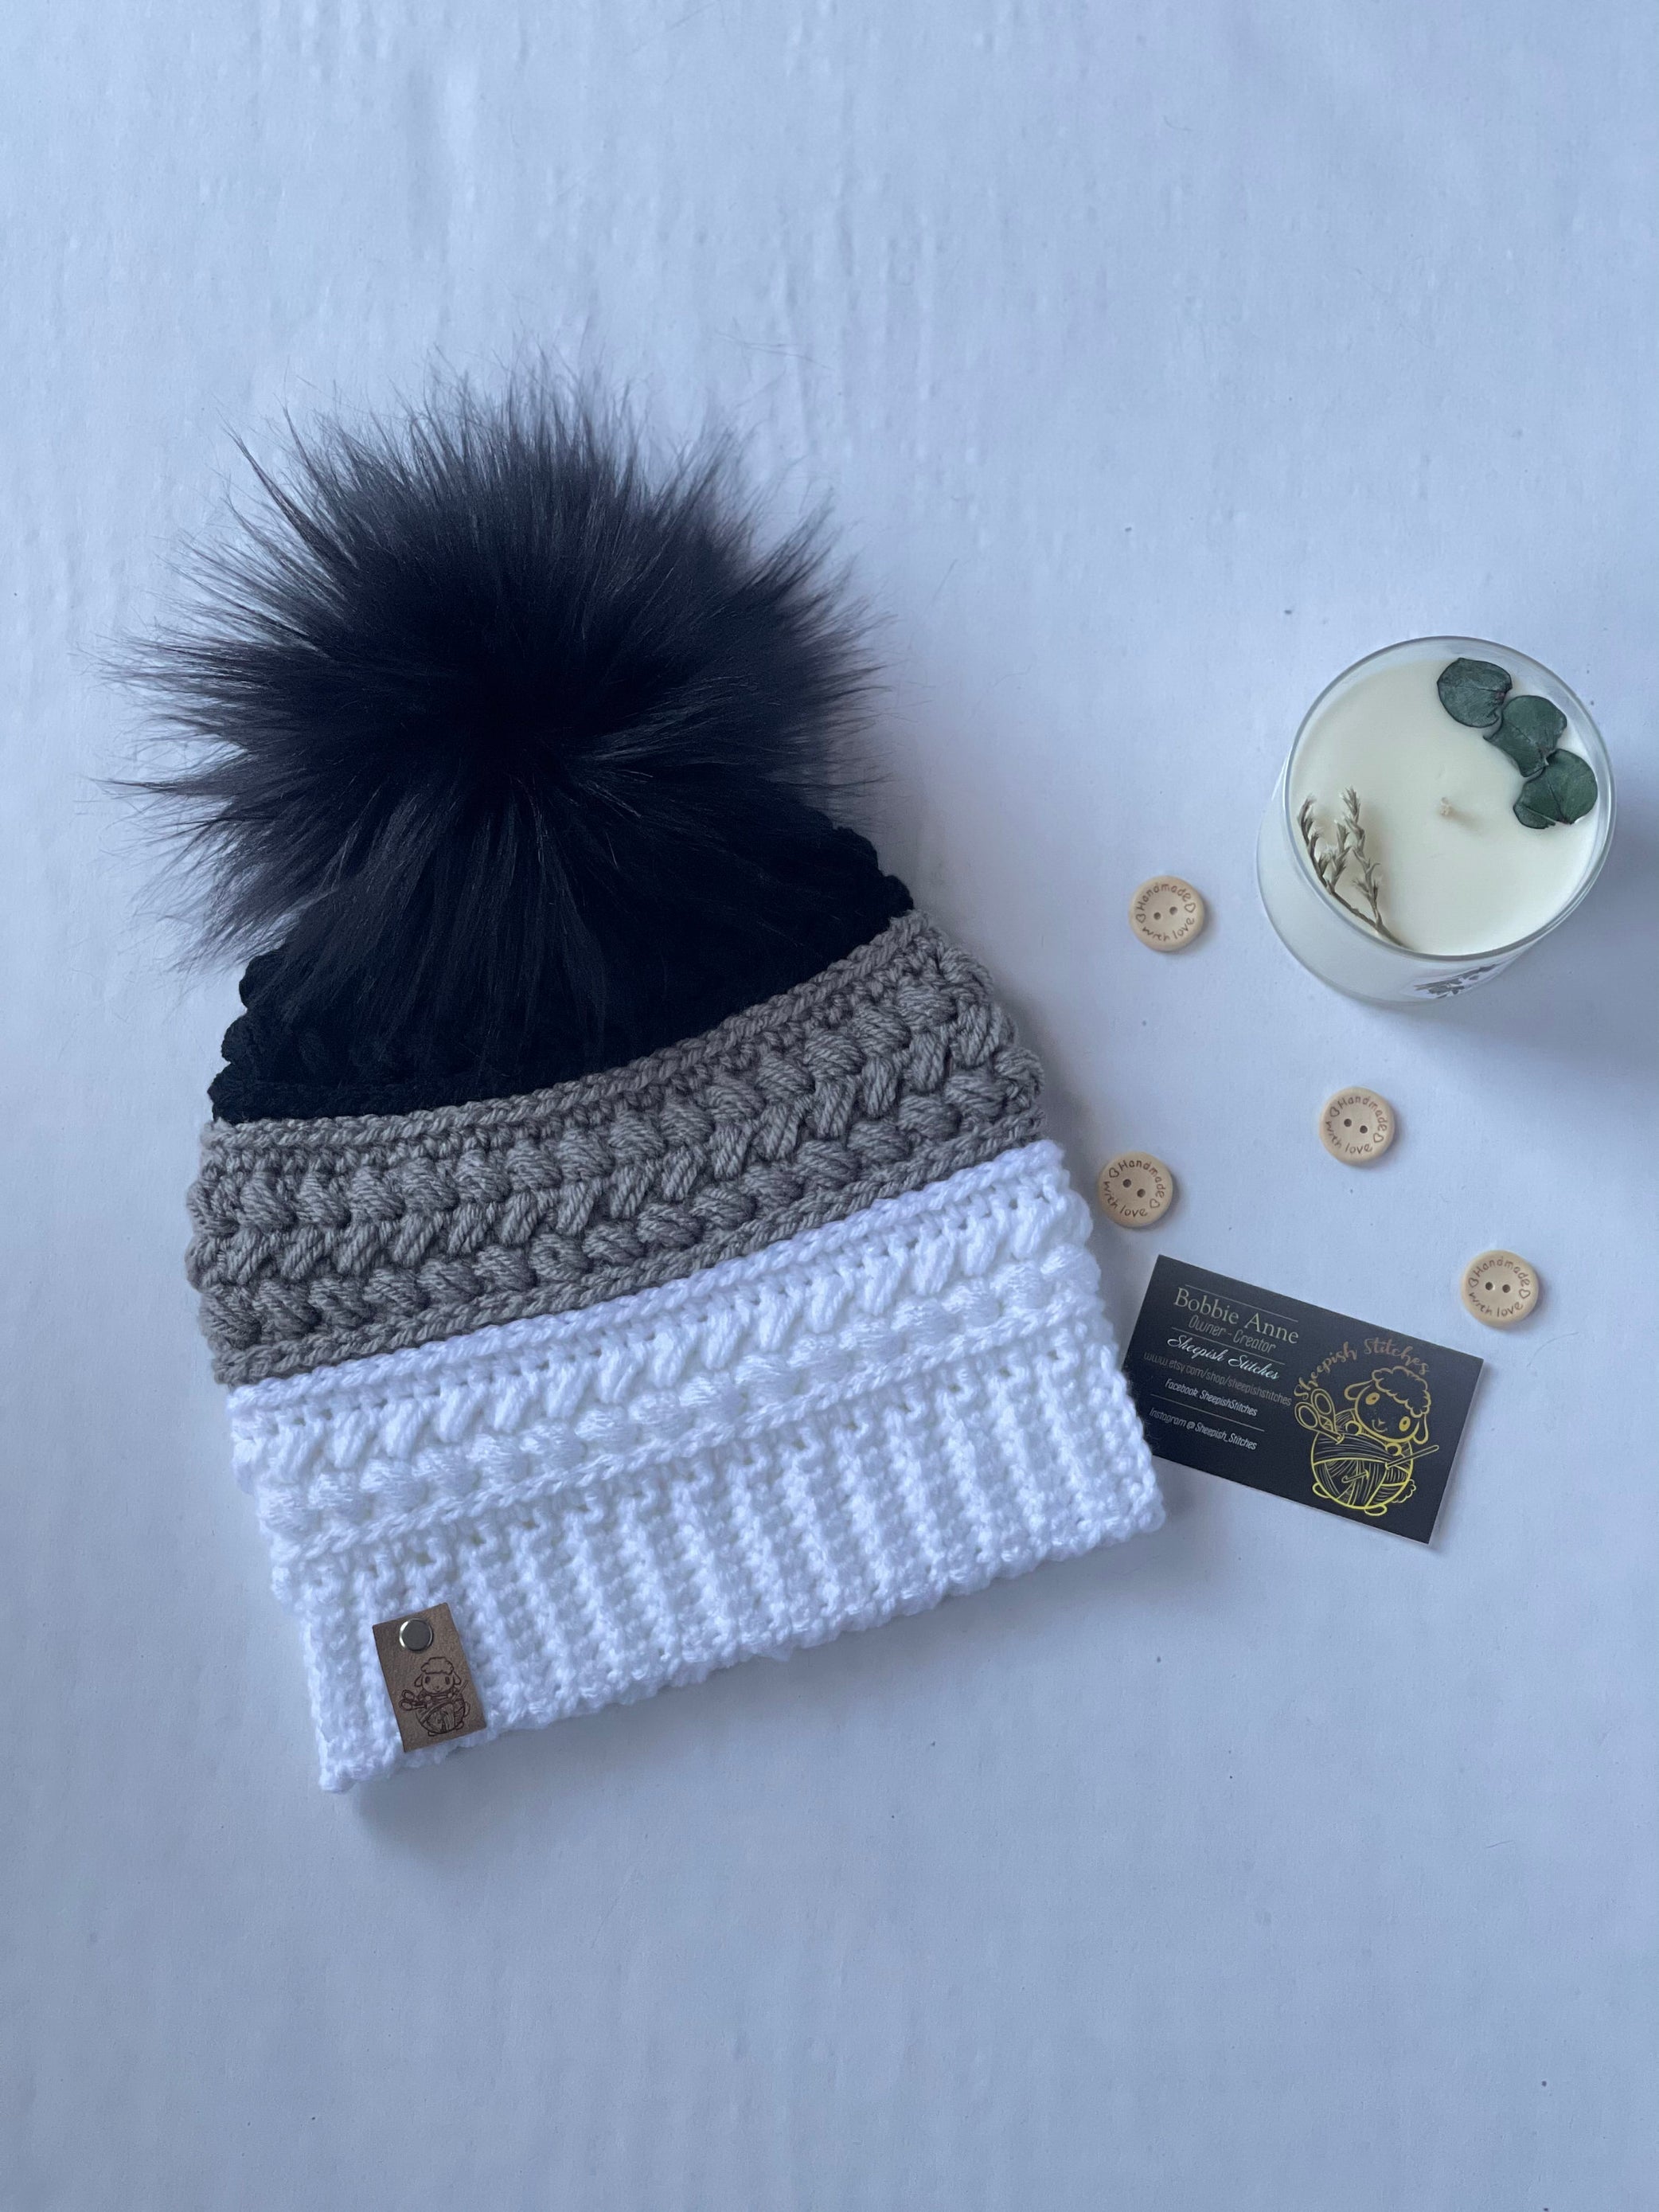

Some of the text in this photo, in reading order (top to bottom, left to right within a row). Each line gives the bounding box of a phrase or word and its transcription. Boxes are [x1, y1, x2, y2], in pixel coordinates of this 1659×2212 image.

[1136, 882, 1192, 911] Handmade
[1142, 917, 1195, 941] with love
[1337, 1094, 1388, 1131] Handmade
[1325, 1120, 1372, 1155] with love
[1117, 1159, 1166, 1198] Handmade
[1103, 1180, 1148, 1217] with love
[1473, 1255, 1531, 1287] Handmade
[1174, 1287, 1298, 1345] Bobbie Anne
[1470, 1292, 1524, 1319] with love
[1188, 1314, 1228, 1339] Owner
[1233, 1329, 1276, 1354] Creator
[1167, 1335, 1279, 1381] Sheepish Stitches
[1294, 1337, 1430, 1399] Sheepish Stitches
[1165, 1378, 1258, 1417] Facebook SheepishStitches
[1149, 1406, 1186, 1428] Instagram
